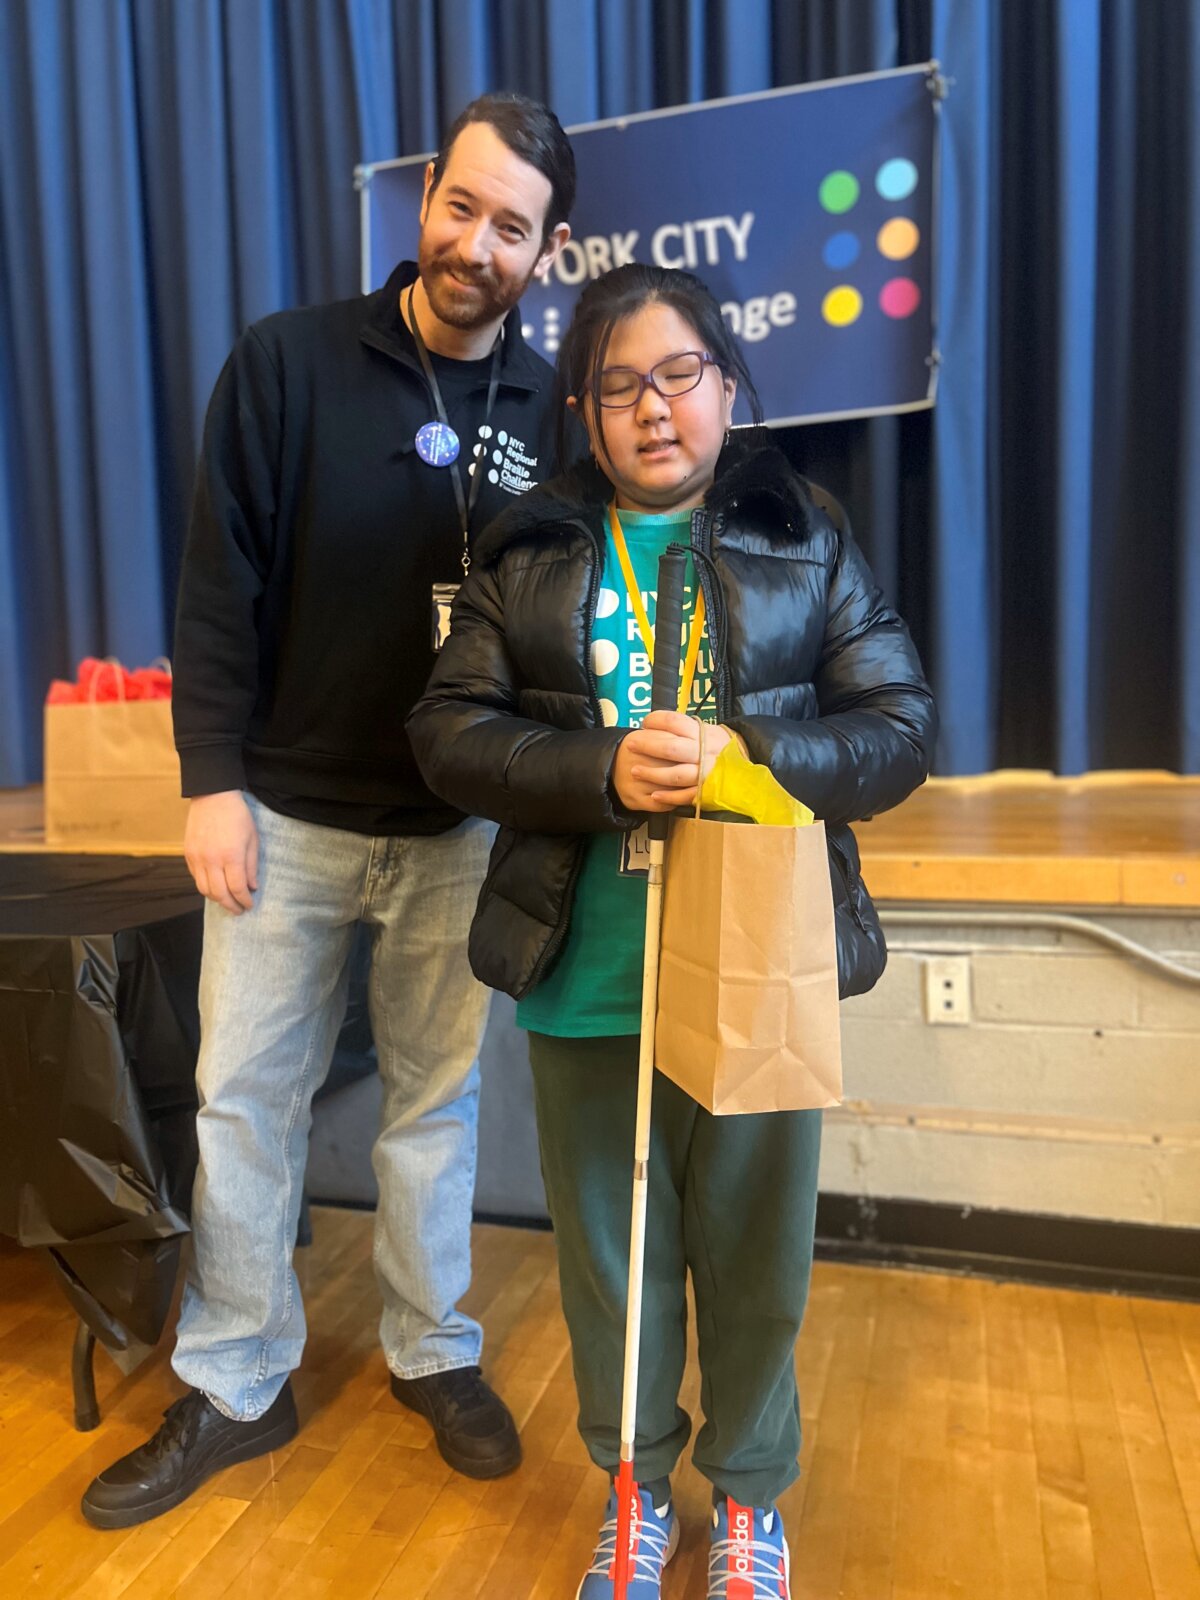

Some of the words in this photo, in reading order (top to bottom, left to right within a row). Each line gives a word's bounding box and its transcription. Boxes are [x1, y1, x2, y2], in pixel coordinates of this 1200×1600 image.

[541, 230, 640, 286] ORK
[651, 211, 755, 270] CITY
[508, 436, 526, 452] NYC
[506, 447, 538, 467] Regional
[503, 458, 531, 479] Braille
